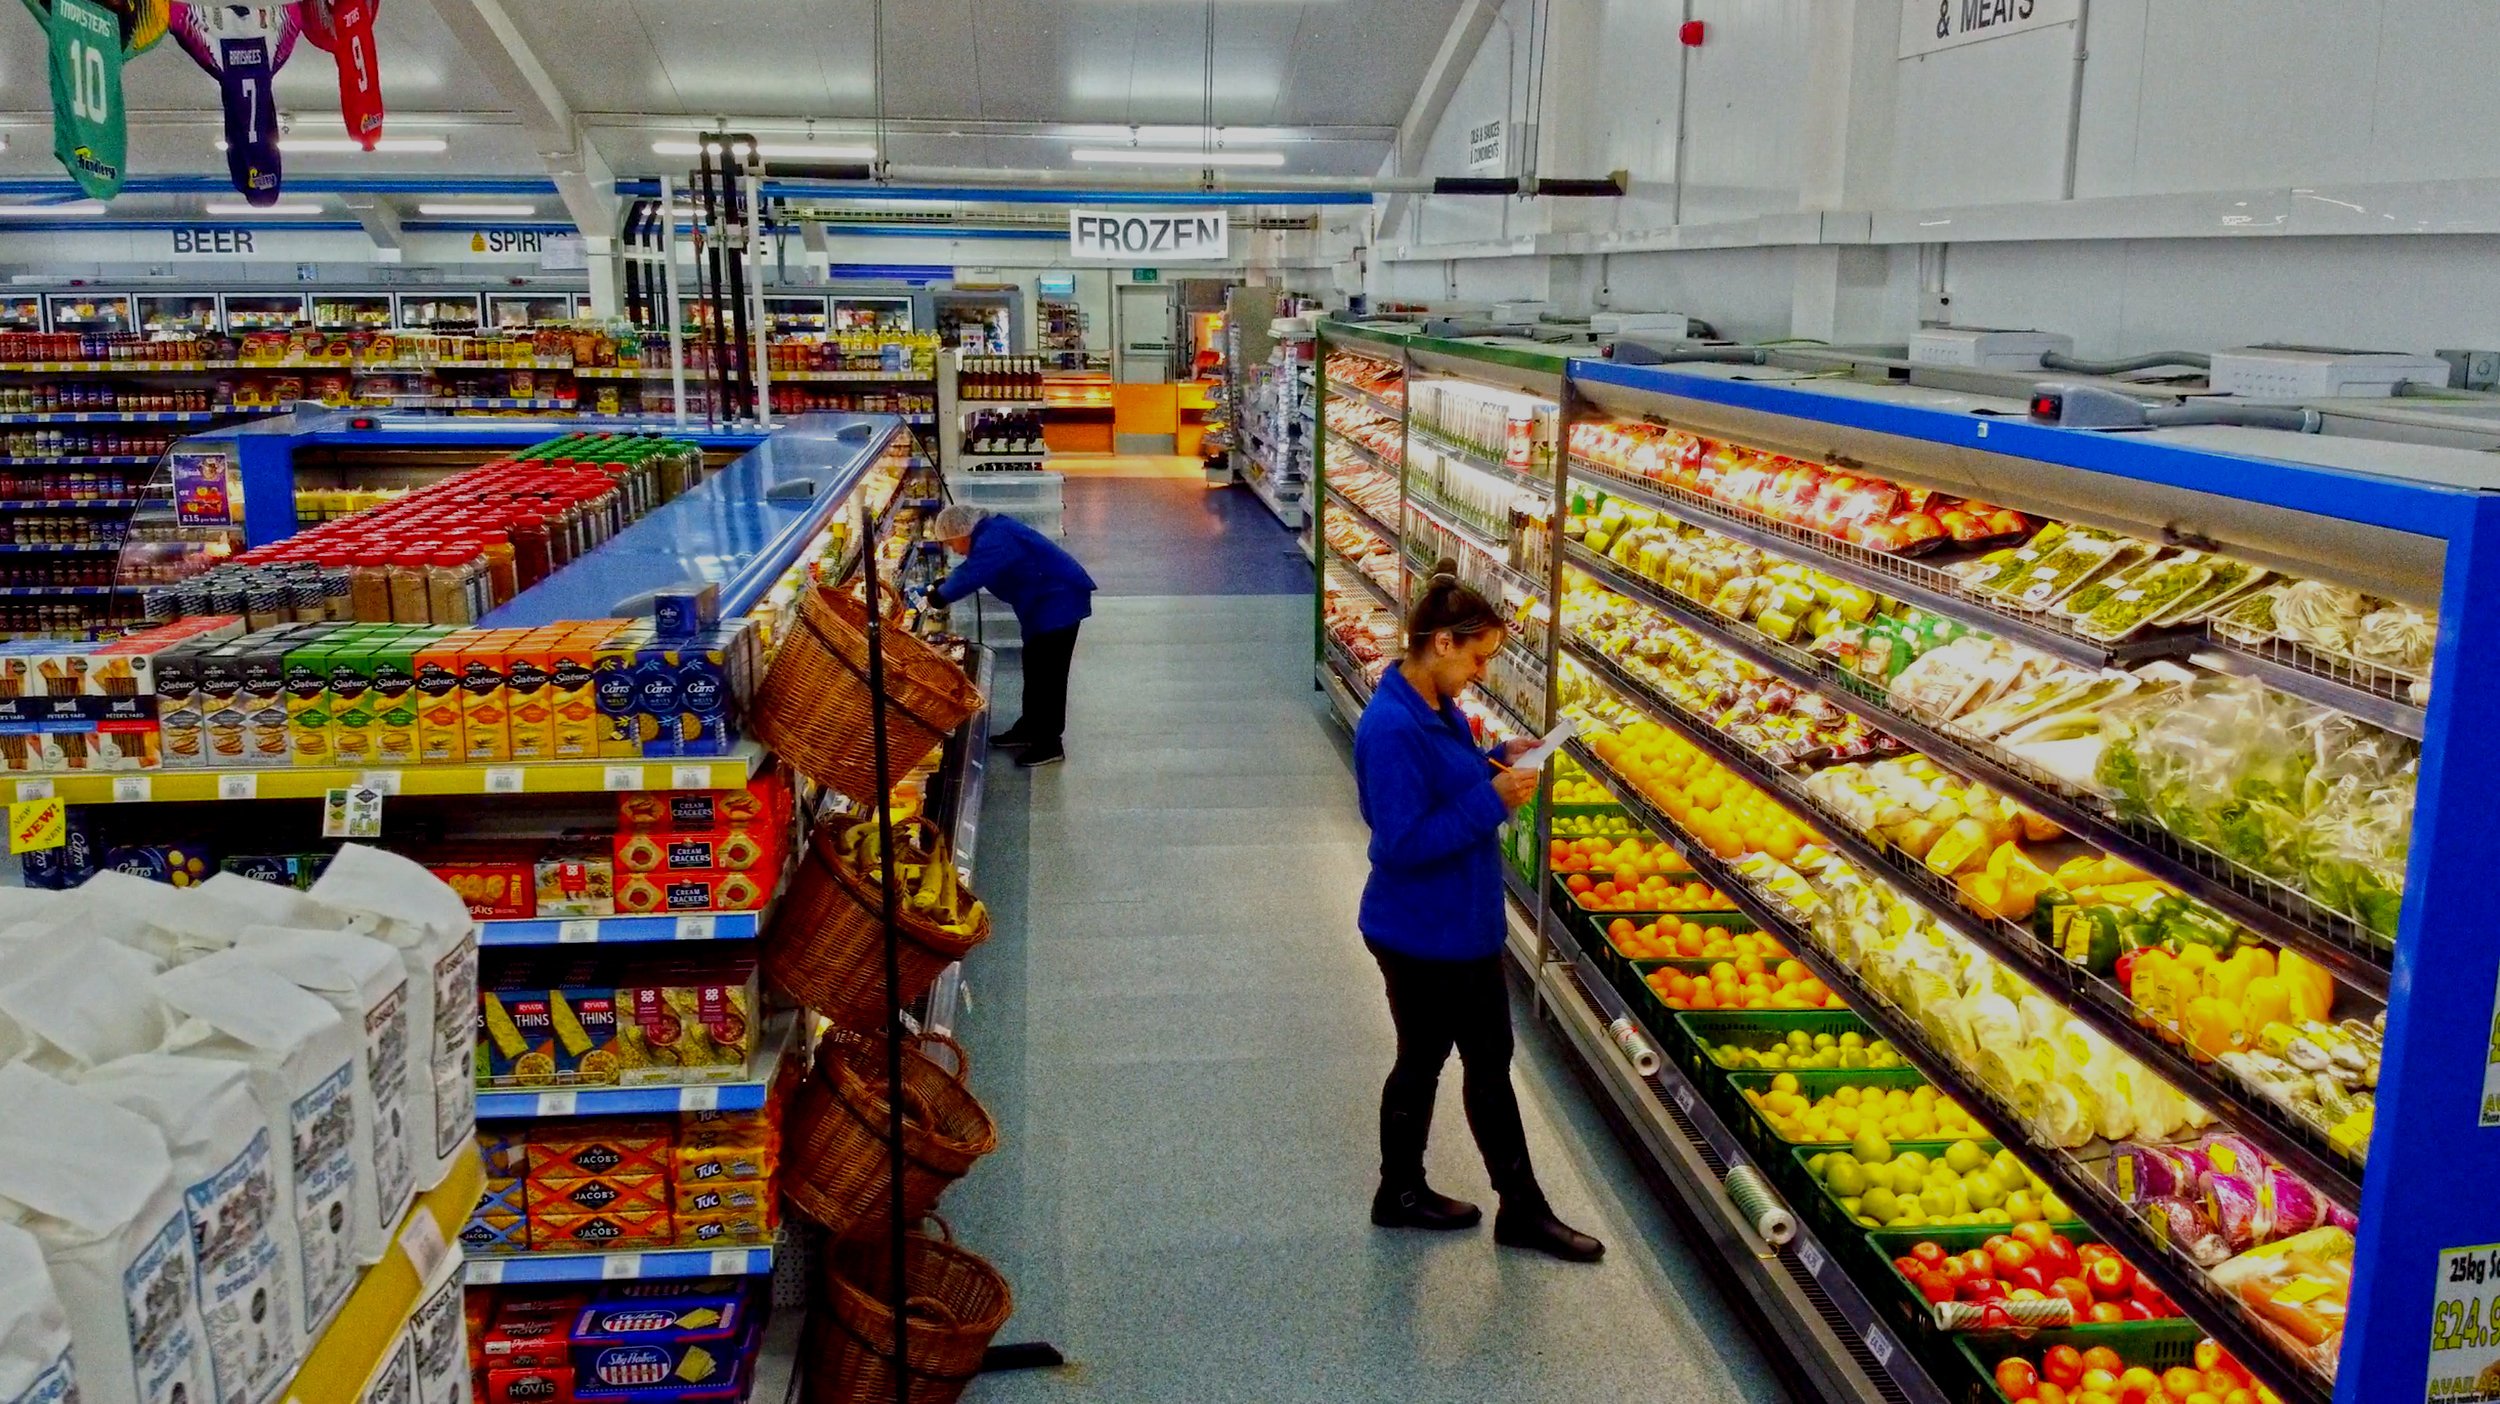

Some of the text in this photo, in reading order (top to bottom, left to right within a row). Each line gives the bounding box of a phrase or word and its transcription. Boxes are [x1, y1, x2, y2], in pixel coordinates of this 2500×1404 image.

[352, 35, 368, 93] 9
[70, 38, 107, 125] 10
[241, 78, 258, 143] 7
[489, 230, 569, 253] SPIRI
[1077, 216, 1219, 253] FROZEN
[173, 230, 254, 254] BEER
[669, 854, 711, 863] CRACKERS
[667, 895, 709, 904] CRACKERS
[514, 1014, 550, 1027] THINS
[579, 1011, 615, 1025] THINS
[577, 1154, 619, 1164] JACOB'S
[695, 1163, 720, 1178] TUC
[574, 1190, 616, 1200] JACOB'S
[695, 1195, 719, 1209] TUC
[577, 1227, 619, 1238] JACOB'S
[2449, 1252, 2486, 1285] 25kg
[508, 1382, 555, 1396] HOVIS
